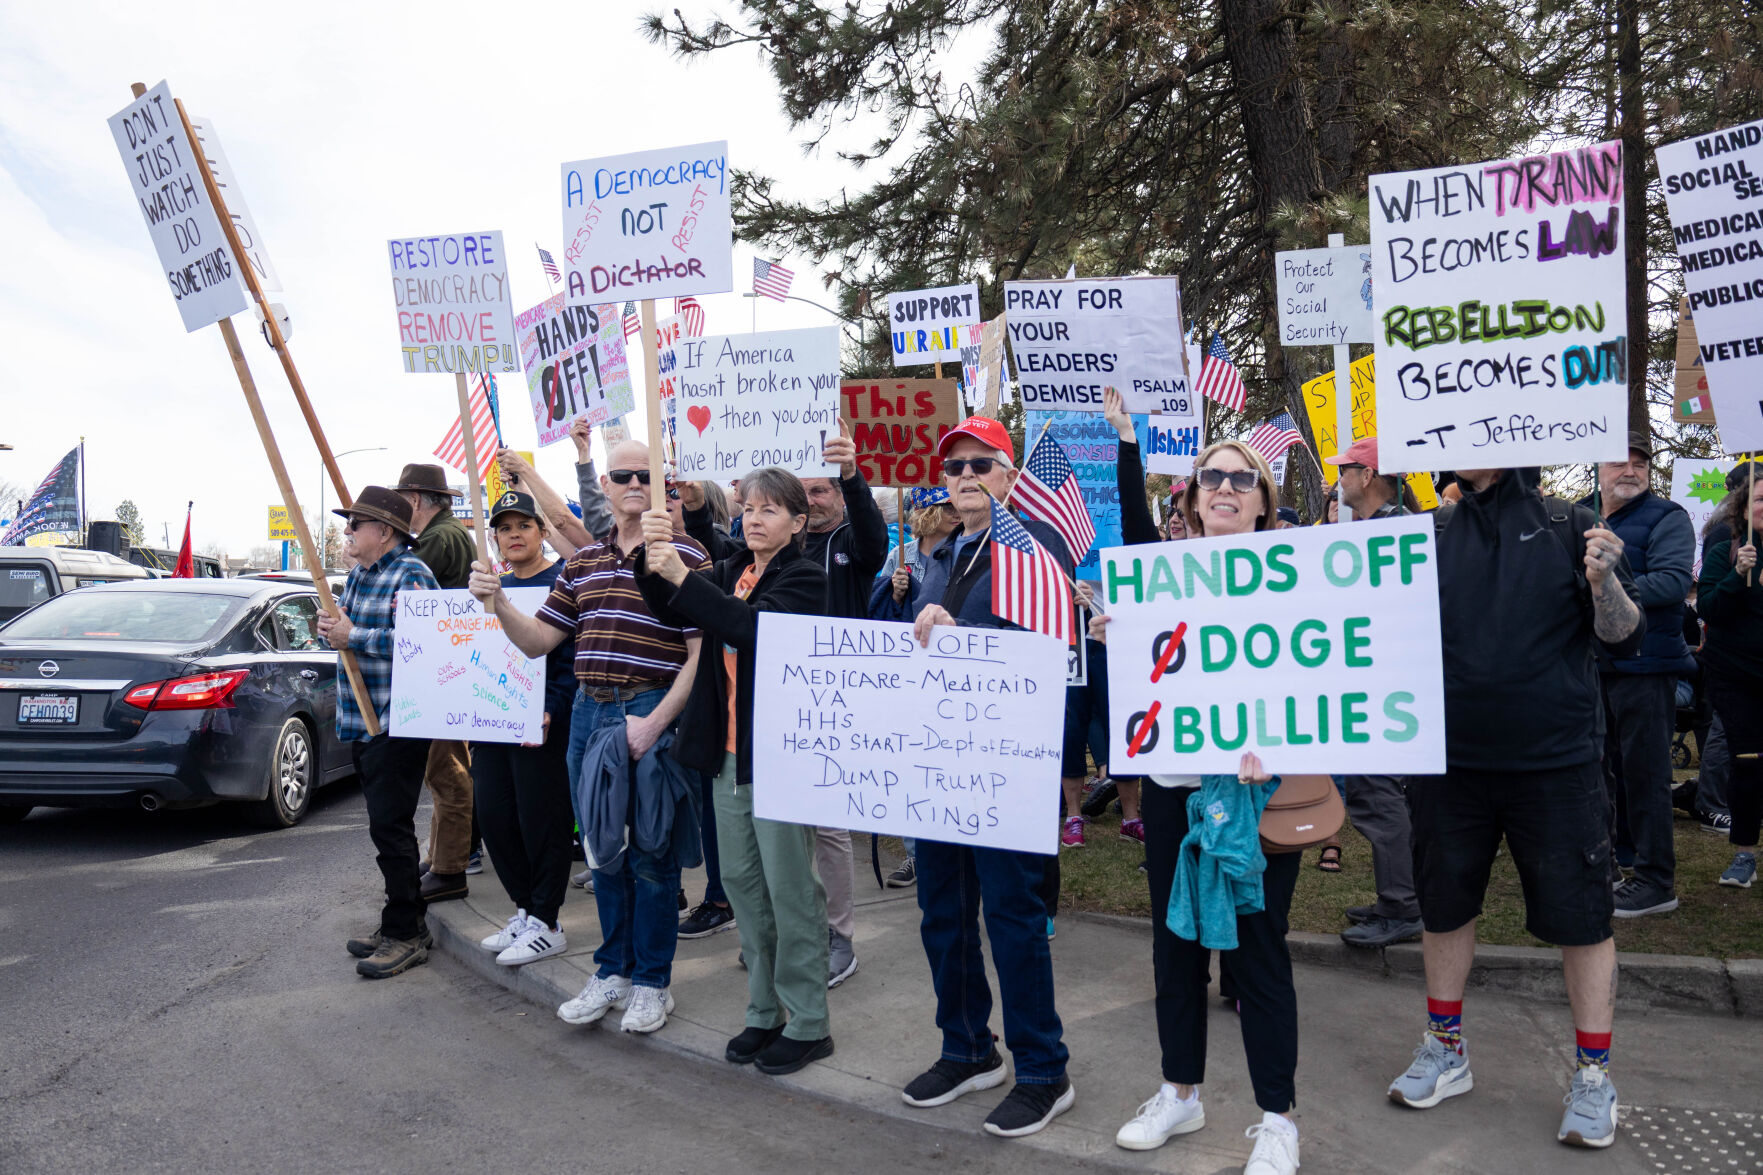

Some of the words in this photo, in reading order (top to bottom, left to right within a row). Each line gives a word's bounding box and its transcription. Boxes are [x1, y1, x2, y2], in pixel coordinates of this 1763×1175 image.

[122, 94, 169, 150] DON'T
[1695, 125, 1763, 160] HAND
[136, 135, 182, 188] JUST
[1666, 159, 1753, 195] SOCIAL
[567, 170, 583, 208] A
[594, 155, 726, 200] DEMOCRACY
[1374, 169, 1485, 223] WHEN
[1484, 140, 1623, 217] TYRANNY
[140, 172, 200, 226] WATCH
[172, 217, 201, 255] DO
[1387, 229, 1530, 283] BECOMES
[1537, 206, 1620, 263] LAW
[390, 235, 495, 270] RESTORE
[1284, 257, 1334, 278] Protect
[1680, 240, 1763, 274] MEDICA
[168, 247, 232, 301] SOMETHING
[393, 271, 505, 307] DEMOCRACY
[568, 270, 585, 298] A
[894, 293, 973, 323] SUPPORT
[1007, 289, 1063, 310] PRAY
[1078, 288, 1123, 310] FOR
[1286, 297, 1327, 315] Social
[398, 311, 497, 344] REMOVE
[534, 305, 600, 361] HANDS
[893, 326, 961, 354] UKRAI
[1009, 321, 1070, 341] YOUR
[1286, 320, 1348, 343] Security
[1381, 300, 1606, 351] REBELLION
[402, 344, 515, 373] TRUMP!!
[683, 340, 707, 369] If
[715, 337, 795, 368] America
[1016, 353, 1118, 373] LEADERS'
[737, 369, 802, 396] broken
[808, 372, 840, 401] your
[1132, 379, 1186, 393] PSALM
[1397, 352, 1556, 401] BECOMES
[840, 384, 937, 419] This
[1022, 384, 1105, 404] DEMISE
[1161, 399, 1188, 412] 109
[771, 408, 799, 437] you
[802, 400, 840, 426] don't
[679, 441, 707, 474] love
[714, 440, 744, 470] her
[751, 429, 827, 471] enough!
[1107, 543, 1299, 604] HANDS
[1322, 532, 1428, 588] OFF
[403, 595, 439, 618] KEEP
[443, 596, 477, 617] YOUR
[437, 617, 482, 633] ORANGE
[484, 616, 504, 632] HAN
[450, 633, 475, 647] OFF
[814, 624, 915, 655] HANDS
[936, 633, 1000, 656] OFF
[1199, 616, 1374, 673] DOGE
[472, 682, 510, 711] Science
[810, 688, 847, 708] VA
[936, 698, 1002, 722] CDC
[471, 710, 526, 738] democracy
[798, 707, 854, 731] HHS
[1173, 690, 1419, 754] BULLIES
